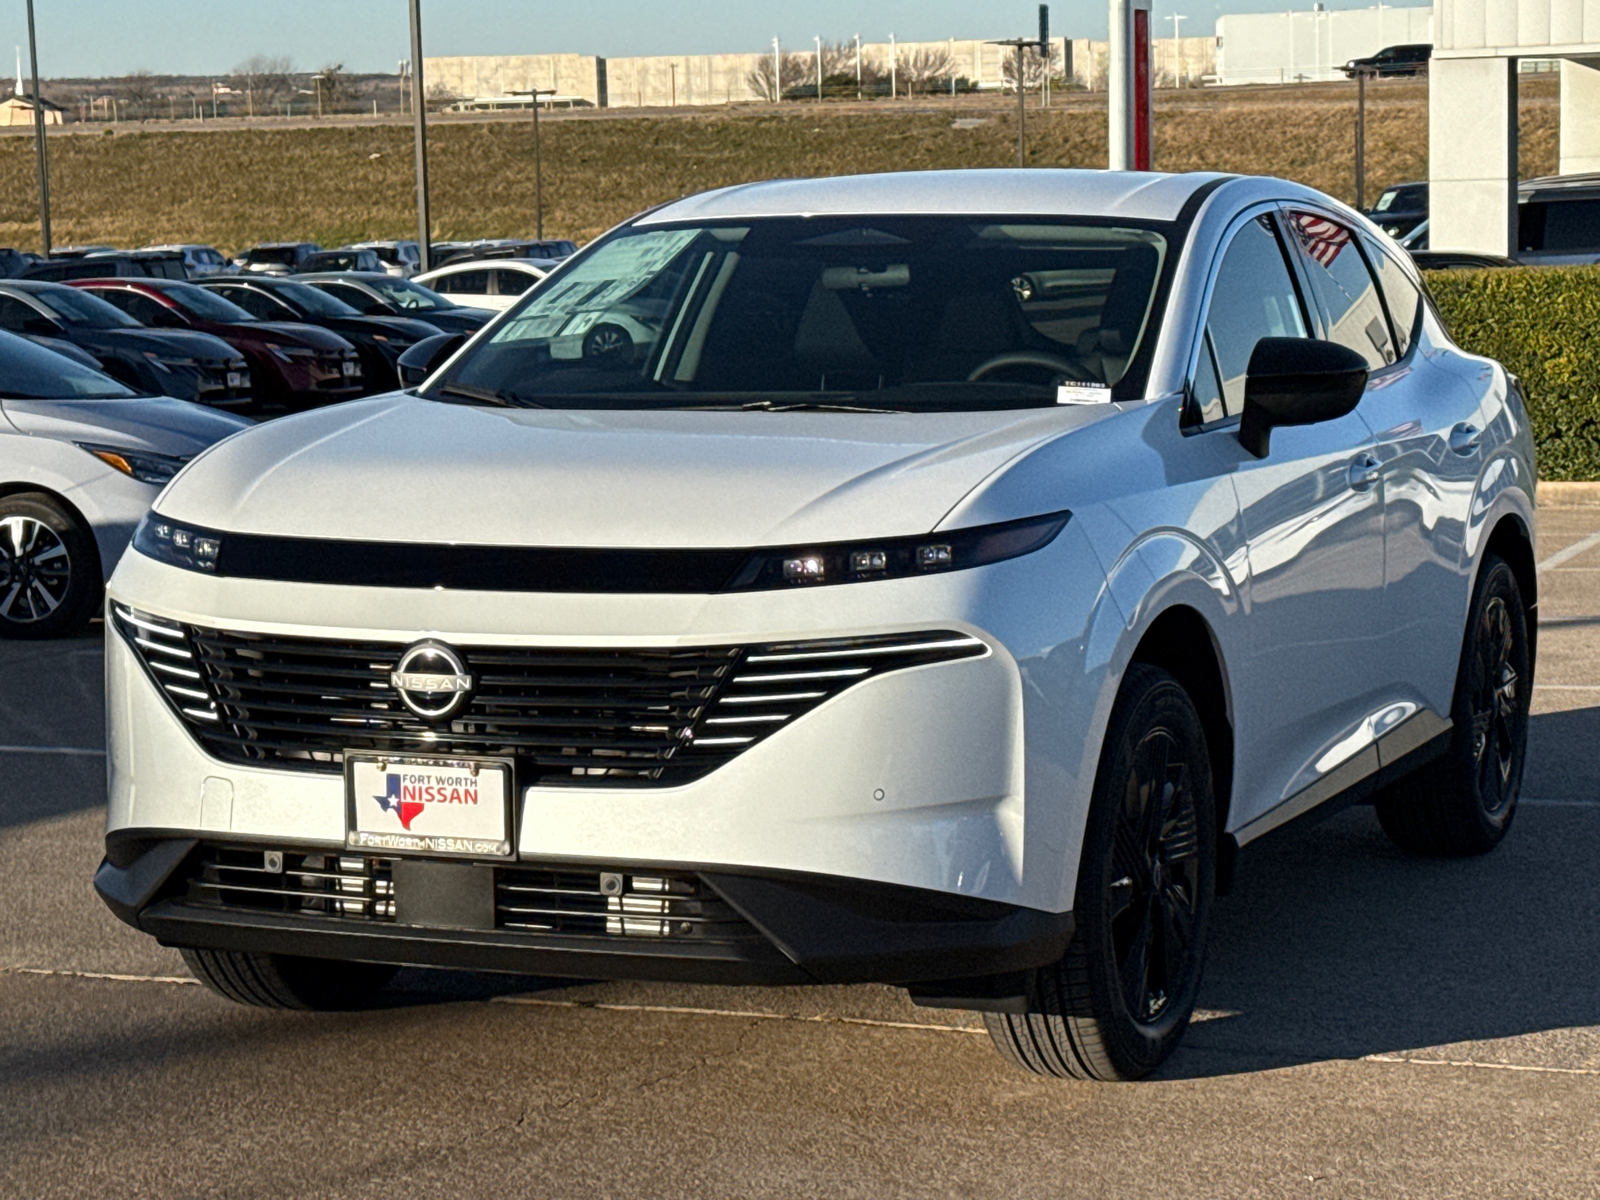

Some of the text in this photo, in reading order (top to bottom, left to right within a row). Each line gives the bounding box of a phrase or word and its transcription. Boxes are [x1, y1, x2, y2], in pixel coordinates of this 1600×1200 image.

[392, 675, 470, 689] NISSAN
[402, 774, 478, 788] FORT WORTH
[403, 785, 478, 805] NISSAN
